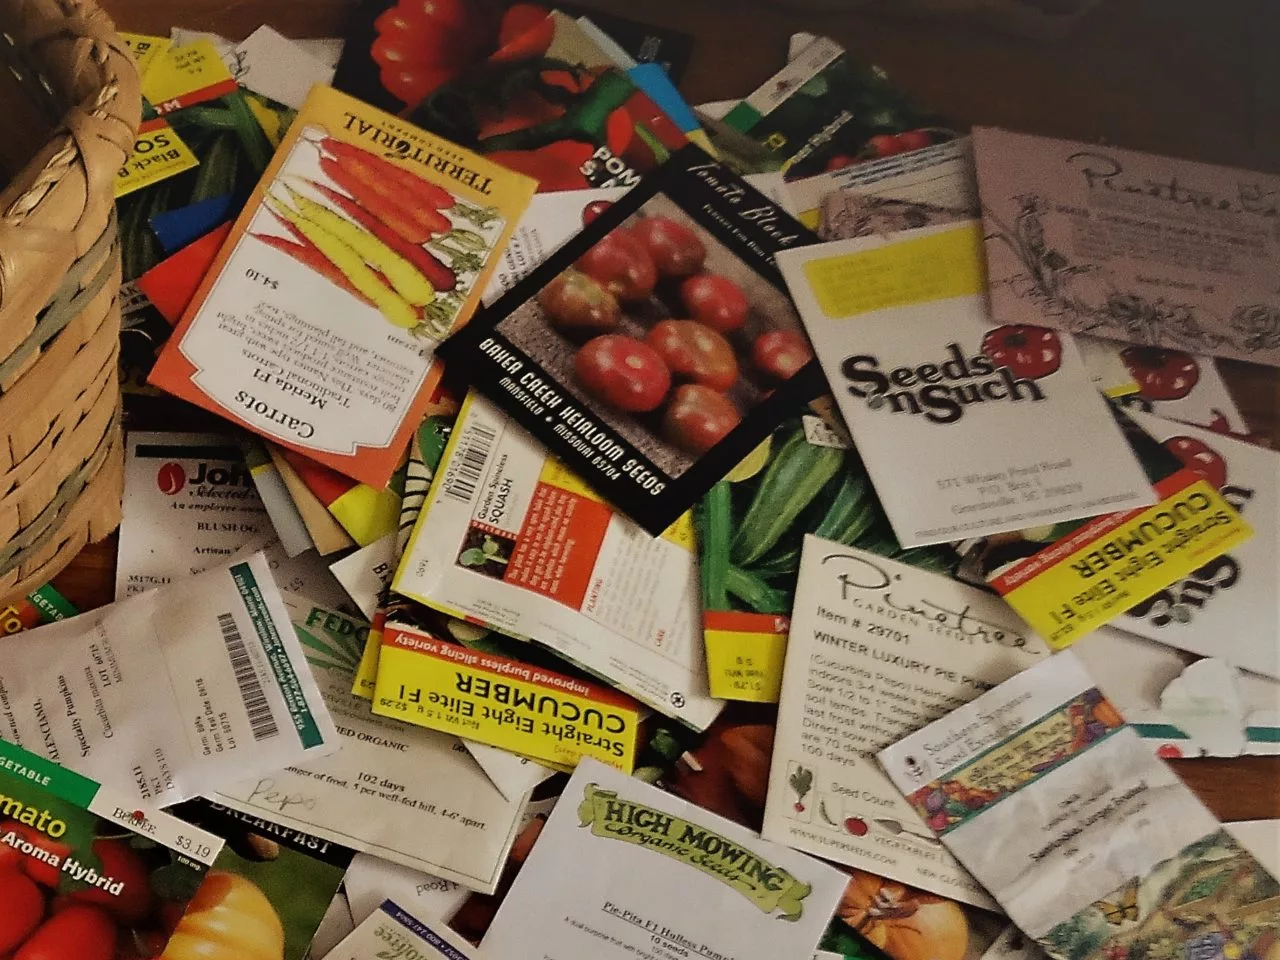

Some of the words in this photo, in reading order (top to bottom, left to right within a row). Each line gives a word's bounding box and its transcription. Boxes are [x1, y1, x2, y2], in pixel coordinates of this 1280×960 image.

[136, 149, 180, 171] Black
[343, 111, 493, 195] TERRITORIAL
[246, 268, 279, 290] $4.10
[841, 344, 996, 399] Seeds
[275, 378, 328, 410] Merida
[918, 366, 1045, 425] Such
[235, 390, 315, 439] Carrots
[478, 338, 523, 374] BAKER
[520, 372, 563, 408] CREEK
[559, 406, 625, 461] HEIRLOOM
[622, 458, 666, 496] SEEDS
[498, 376, 545, 416] MANSFIELD
[553, 423, 595, 459] MISSOURI
[591, 454, 621, 481] 65704
[489, 478, 513, 525] SQUASH
[1070, 492, 1210, 581] CUCUMBER
[817, 605, 847, 625] Item
[395, 633, 439, 655] variety
[440, 642, 478, 665] slicing
[813, 629, 869, 656] WINTER
[872, 648, 931, 674] LUXURY
[934, 667, 958, 682] PIE
[481, 653, 530, 680] burpless
[58, 675, 77, 716] Pumpkins
[533, 671, 590, 697] improved
[428, 691, 474, 717] Elite
[455, 672, 625, 734] CUCUMBER
[482, 706, 534, 734] Eight
[356, 732, 409, 752] ORGANIC
[542, 722, 624, 758] Straight
[356, 771, 378, 785] 102
[379, 777, 406, 793] days
[2, 825, 61, 868] Aroma
[61, 856, 126, 896] Hybrid
[175, 835, 211, 859] $3.19
[604, 800, 674, 836] HIGH
[677, 825, 785, 892] MOWING
[603, 901, 643, 924] Pie-Pita
